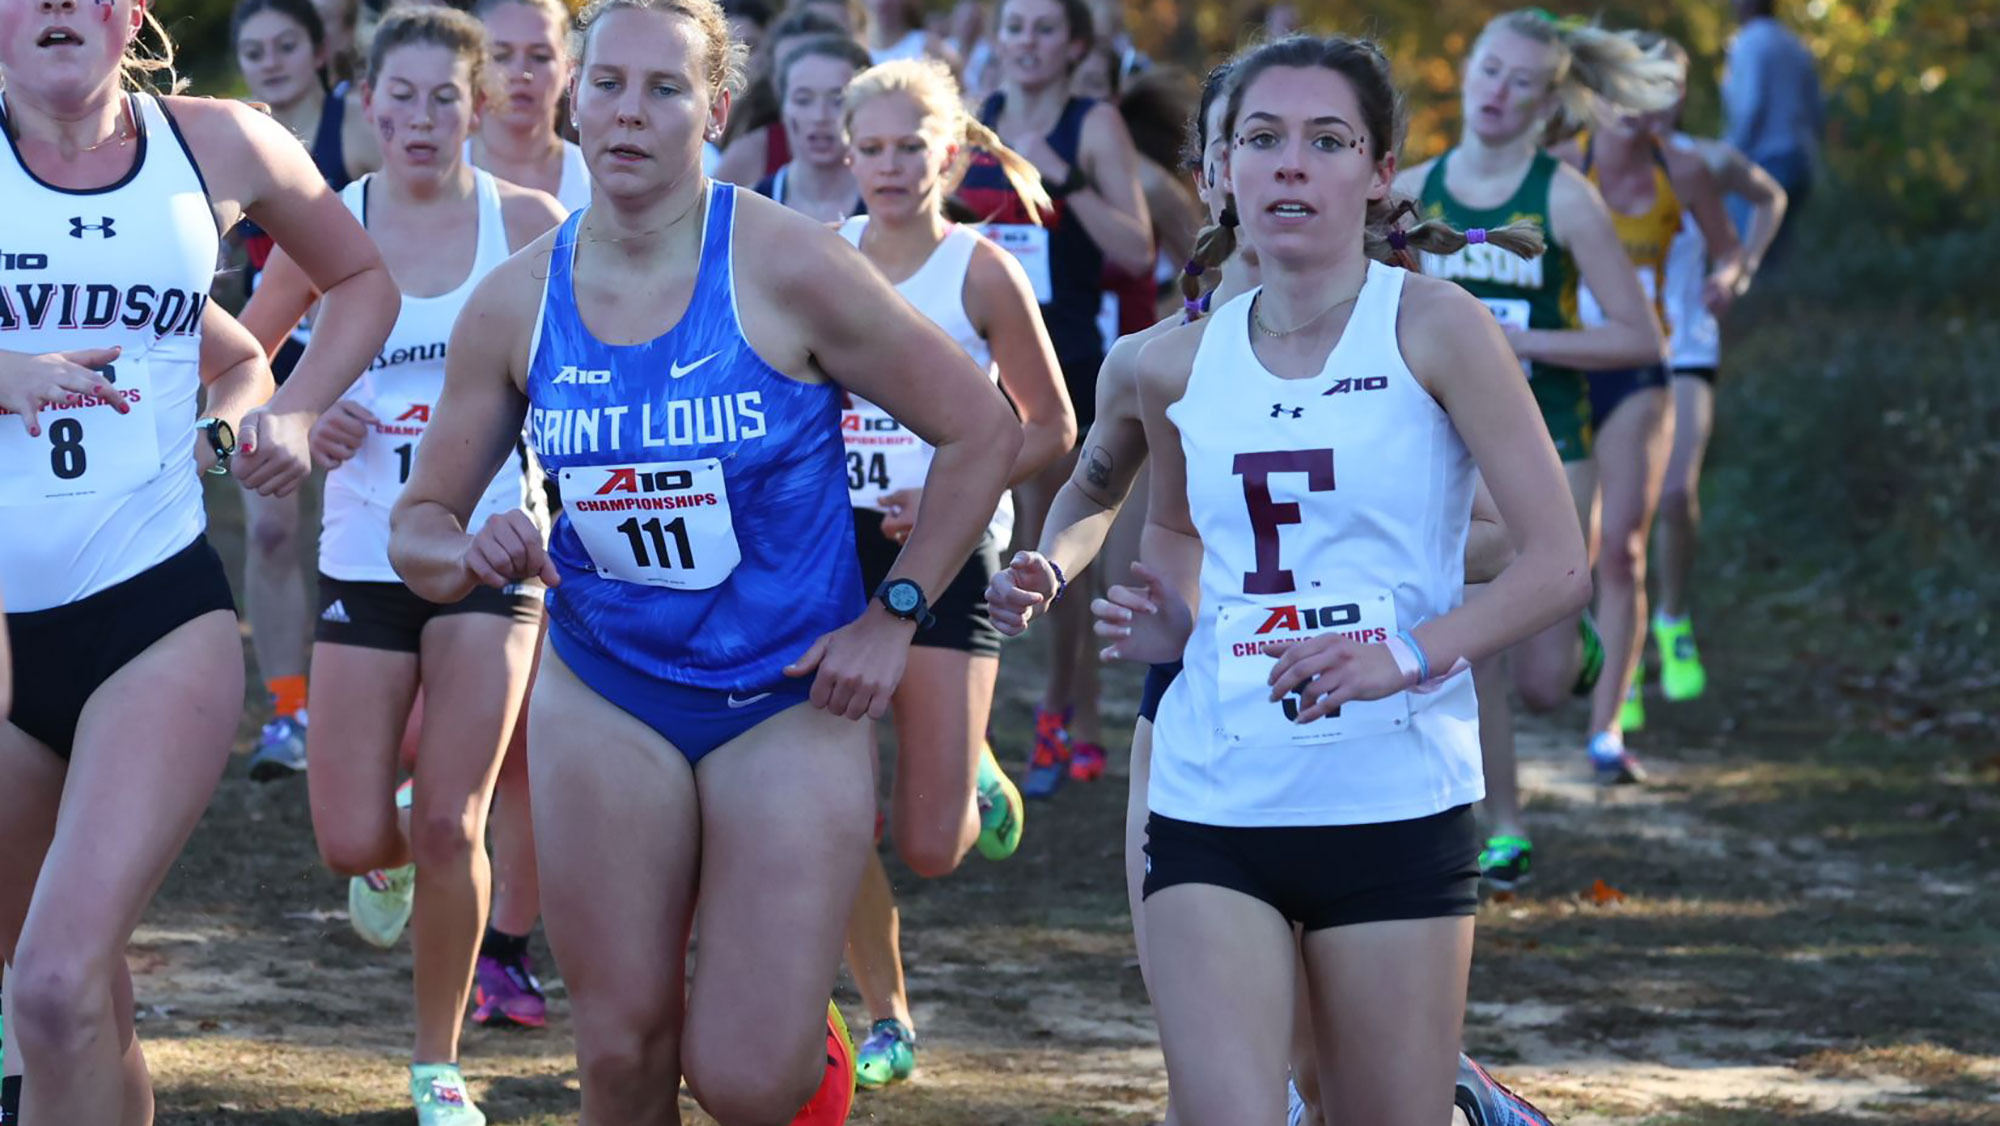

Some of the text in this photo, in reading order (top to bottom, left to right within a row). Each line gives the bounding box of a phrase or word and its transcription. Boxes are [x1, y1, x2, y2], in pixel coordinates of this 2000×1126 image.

[0, 249, 48, 270] 10
[551, 365, 611, 384] A10
[1321, 376, 1388, 396] A10
[532, 390, 767, 455] SAINT LOUIS
[48, 417, 87, 480] 8
[394, 443, 412, 484] 1
[594, 467, 693, 495] A10
[846, 451, 891, 490] 34
[575, 493, 718, 512] CHAMPIONSHIPS
[1232, 448, 1336, 595] F
[616, 516, 696, 570] 111
[1254, 602, 1361, 635] A10
